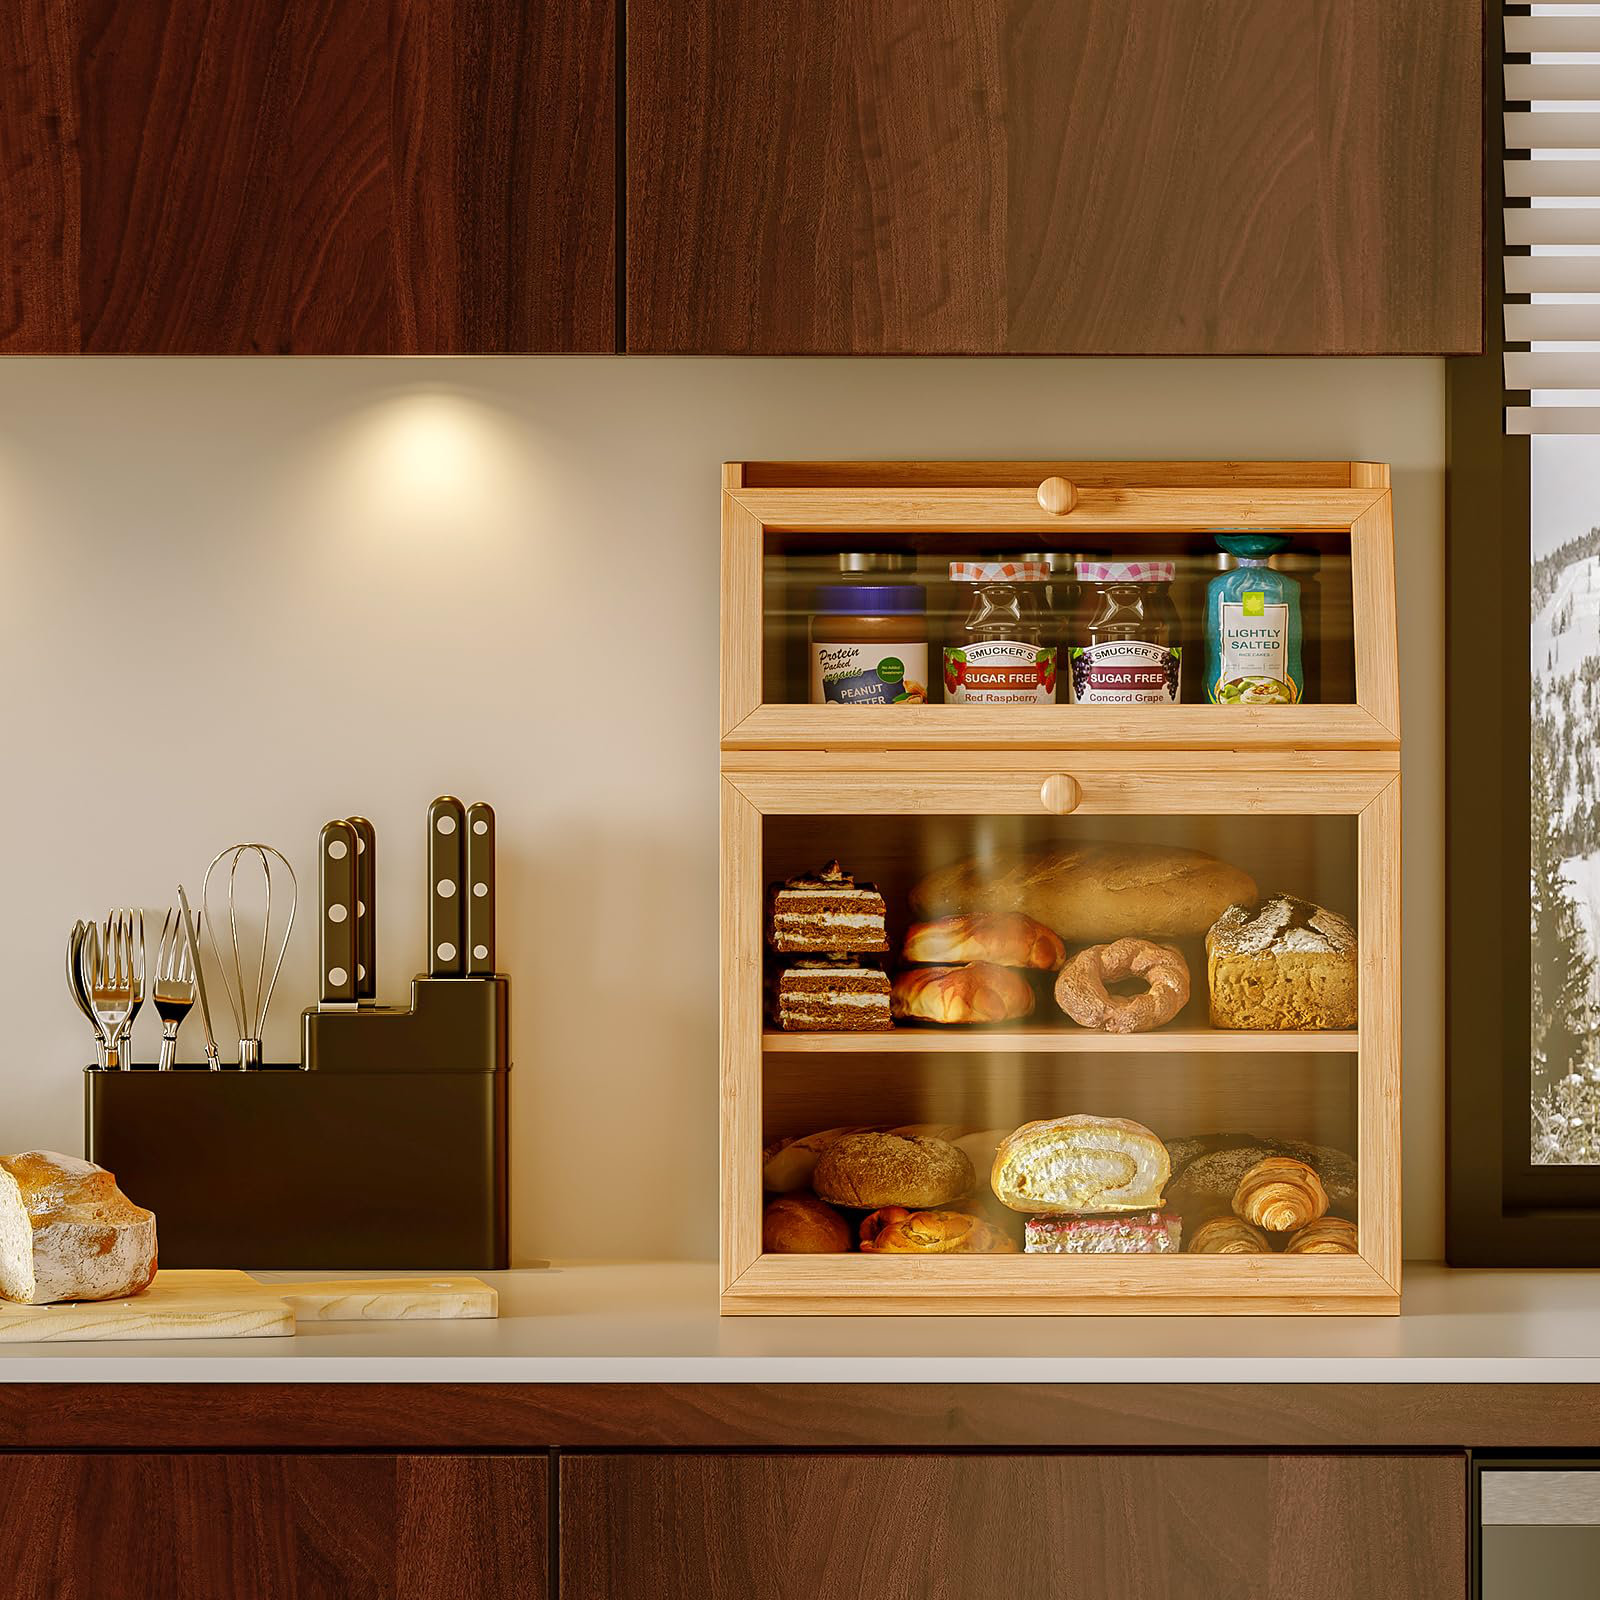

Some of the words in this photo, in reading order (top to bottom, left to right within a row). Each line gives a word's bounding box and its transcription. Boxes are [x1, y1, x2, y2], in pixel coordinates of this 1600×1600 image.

[1228, 629, 1281, 638] LIGHTLY
[1231, 641, 1280, 650] SALTED
[819, 648, 860, 664] Protein
[969, 646, 1034, 660] SMUCKER'S
[1094, 646, 1159, 660] SMUCKER'S
[823, 659, 851, 672] Packed
[824, 667, 862, 685] organic
[965, 673, 1006, 683] SUGAR
[1009, 673, 1038, 683] FREE
[1090, 673, 1131, 683] SUGAR
[1134, 673, 1163, 683] FREE
[841, 683, 883, 699] PEANUT
[965, 694, 983, 702] Red
[986, 694, 1038, 704] Raspberry
[1089, 694, 1133, 702] Concord
[1135, 694, 1164, 704] Grape
